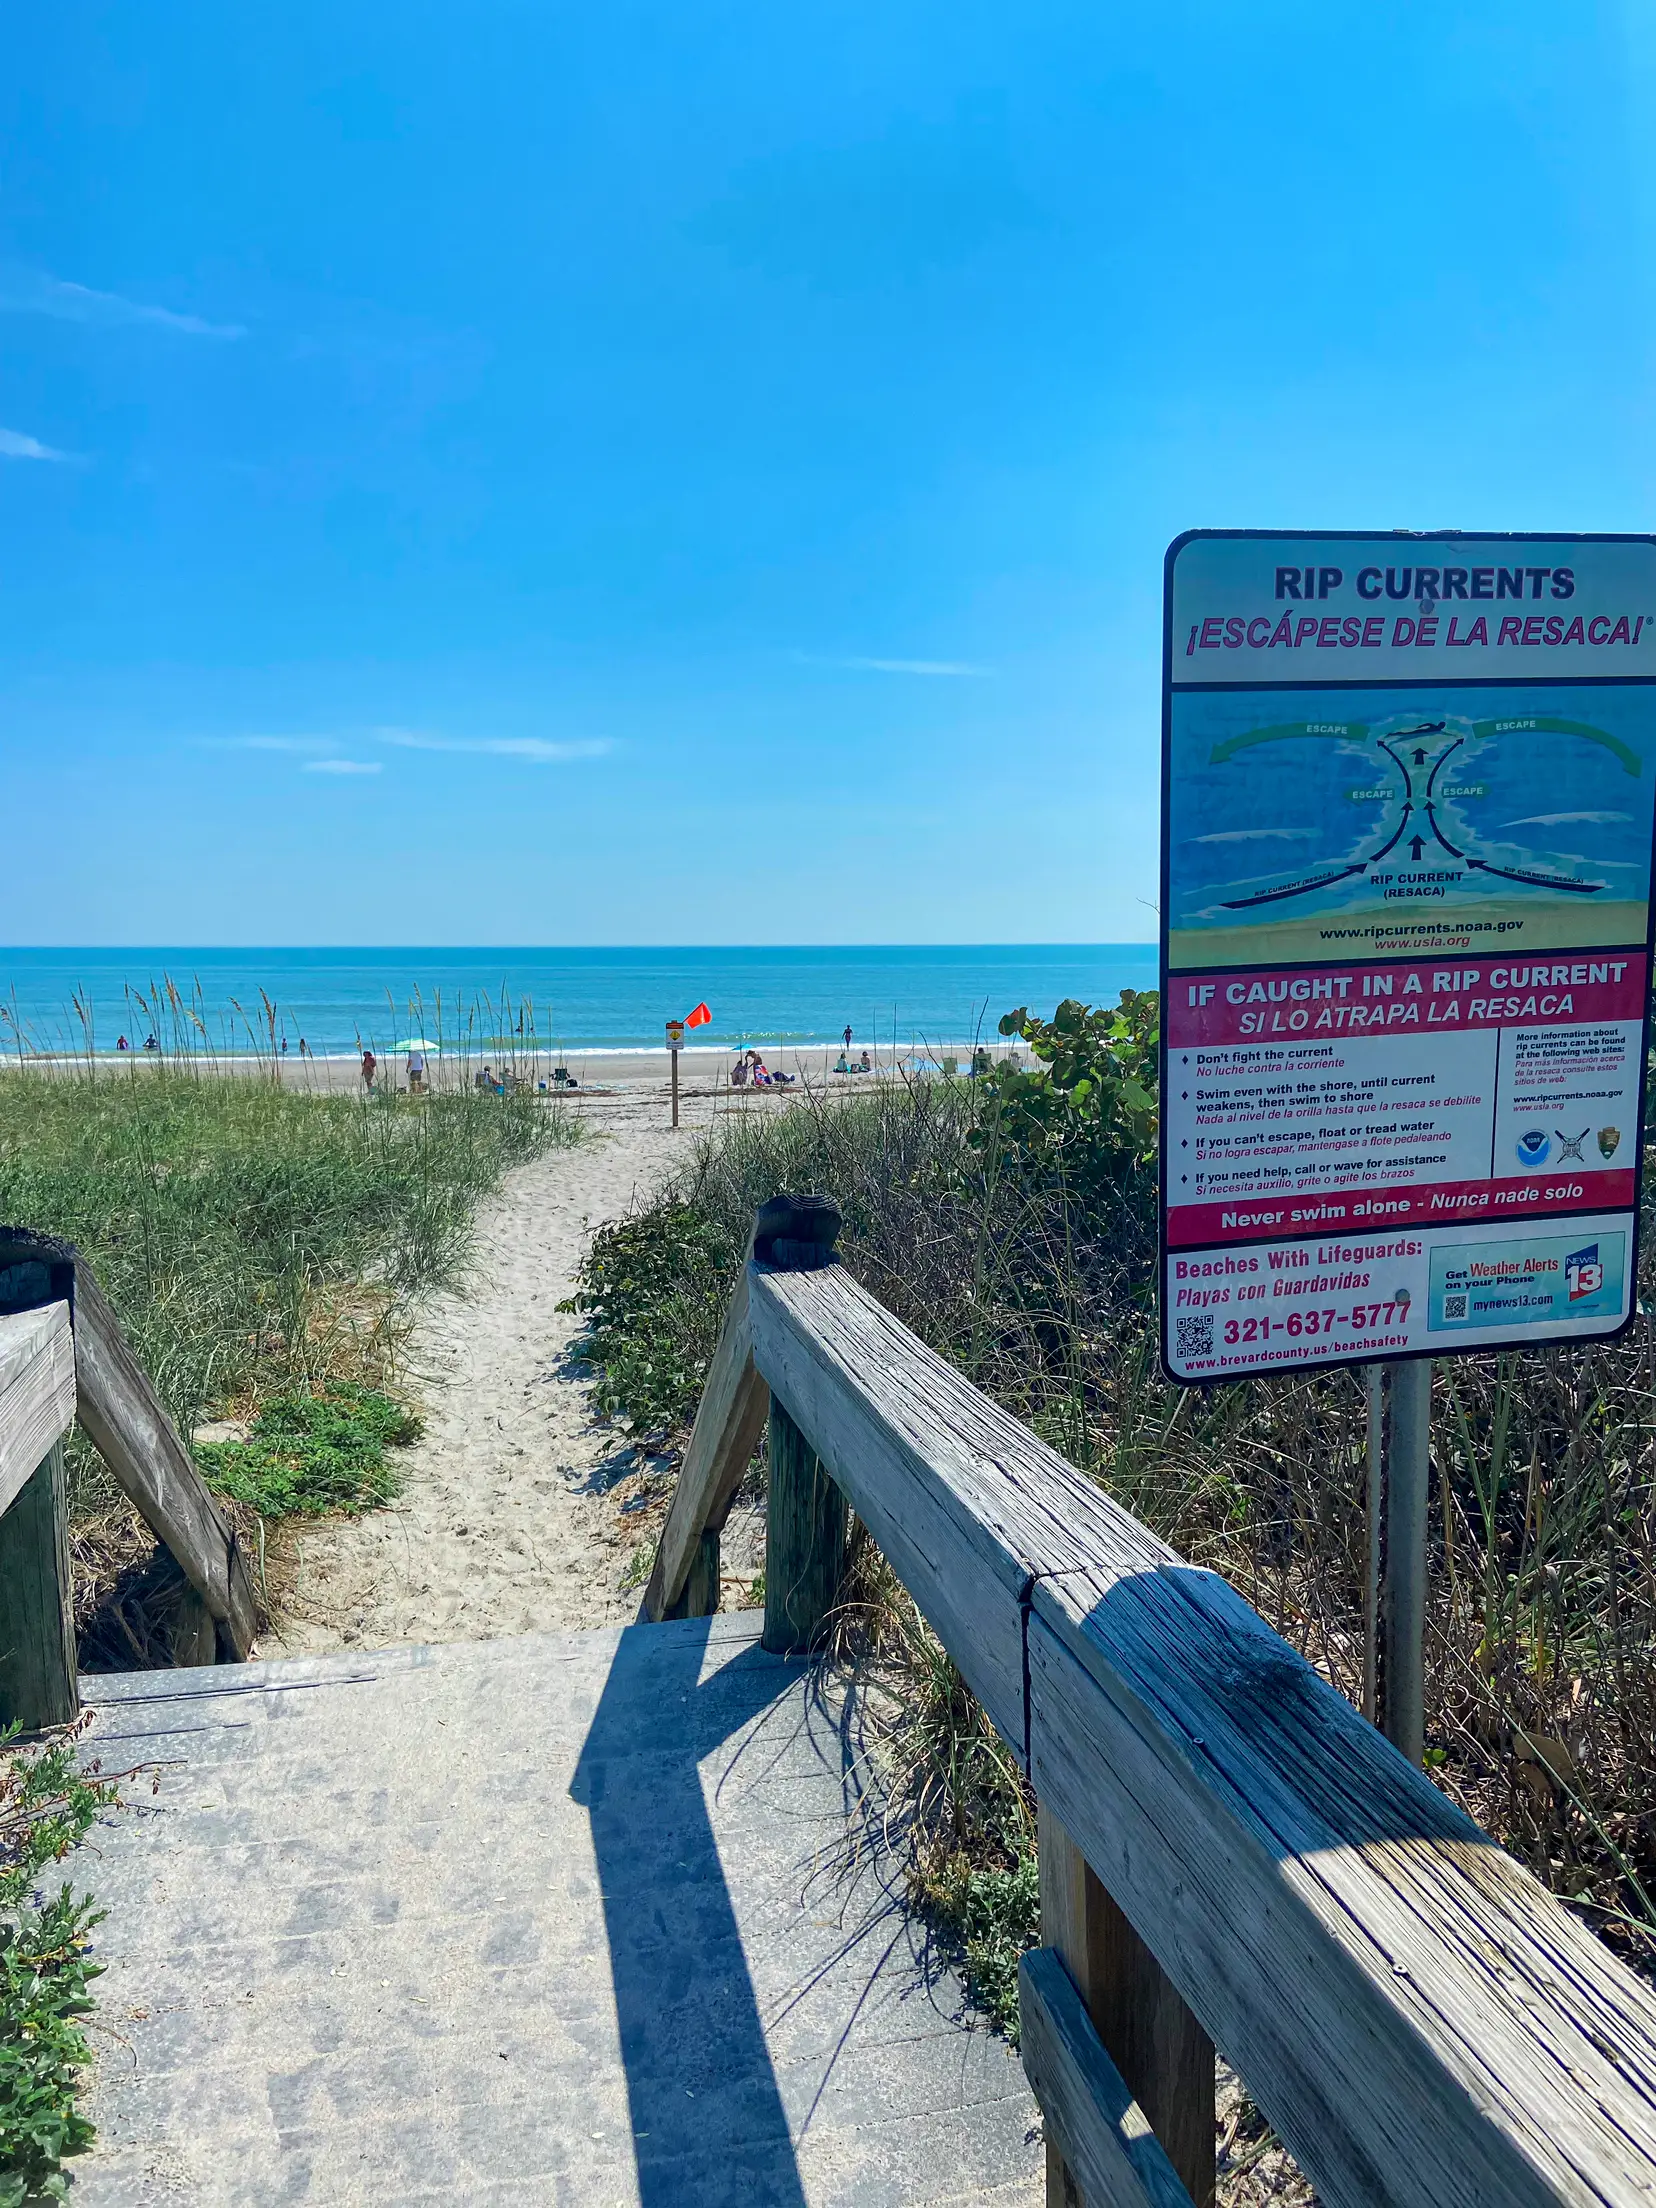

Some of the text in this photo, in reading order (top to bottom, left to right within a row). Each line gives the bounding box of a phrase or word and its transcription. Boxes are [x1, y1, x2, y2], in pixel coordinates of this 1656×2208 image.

[1274, 567, 1575, 600] RIP CURRENTS
[1186, 610, 1385, 656] ¡ESCÁPESE
[1391, 617, 1439, 647] DE
[1446, 617, 1489, 646] LA
[1306, 725, 1348, 735] ESCAPE
[1496, 720, 1536, 731] ESCAPE
[1352, 790, 1393, 798] ESCAPE
[1443, 787, 1483, 796] ESCAPE
[1371, 872, 1464, 884] RIP CURRENT
[1384, 887, 1445, 900] (RESACA)
[1320, 920, 1524, 940] www.ripcurrents.noaa.gov
[1375, 936, 1470, 950] www.usla.org
[1188, 962, 1628, 1007] IF CAUGHT IN A RIP CURRENT
[1239, 994, 1574, 1034] SI LO ATRAPA LA RESACA
[1517, 1028, 1618, 1041] More information about
[1531, 1040, 1567, 1048] currents
[1233, 1051, 1261, 1063] fight
[1265, 1050, 1284, 1059] the
[1288, 1046, 1333, 1058] current
[1527, 1050, 1540, 1058] the
[1542, 1048, 1580, 1057] following
[1583, 1046, 1600, 1054] web
[1602, 1046, 1625, 1054] sites:
[1197, 1058, 1344, 1077] No luche contra la corriente
[1196, 1074, 1435, 1100] Swim even with the shore, until current
[1514, 1090, 1623, 1103] www.ripcurrents.noaa.gov
[1196, 1092, 1374, 1112] weakens, then swim to shore
[1196, 1095, 1481, 1125] Nada al nivel de la orilla hasta que la resaca se debilite
[1513, 1102, 1564, 1112] www.usla.org
[1196, 1138, 1205, 1147] If
[1209, 1138, 1231, 1149] you
[1268, 1131, 1315, 1142] escape,
[1318, 1126, 1346, 1138] float
[1350, 1127, 1362, 1135] or
[1366, 1123, 1397, 1134] tread
[1401, 1121, 1435, 1131] water
[1196, 1150, 1206, 1160] Si
[1209, 1151, 1222, 1159] no
[1225, 1148, 1250, 1160] logra
[1253, 1144, 1295, 1156] escapar,
[1362, 1138, 1367, 1146] a
[1370, 1136, 1392, 1146] flote
[1394, 1131, 1451, 1146] pedaleando
[1196, 1154, 1447, 1184] If you need help, call or wave for assistance
[1196, 1169, 1415, 1195] Si necesita auxilio, grite o agite los brazos
[1221, 1210, 1284, 1228] Never
[1290, 1203, 1346, 1222] swim
[1353, 1198, 1411, 1216] alone
[1431, 1190, 1489, 1209] Nunca
[1495, 1186, 1540, 1204] nade
[1544, 1183, 1584, 1200] solo
[1175, 1238, 1422, 1279] Beaches With Lifeguards:
[1567, 1256, 1596, 1264] NEWS
[1445, 1258, 1559, 1280] Get Weather Alerts
[1567, 1264, 1602, 1291] 13
[1176, 1271, 1370, 1308] Playas con Guardavidas
[1445, 1275, 1535, 1290] on your Phone
[1473, 1295, 1553, 1312] mynews13.com
[1223, 1301, 1411, 1344] 321-637-5777
[1184, 1334, 1409, 1371] www.brevardcounty.us/beachsafety
